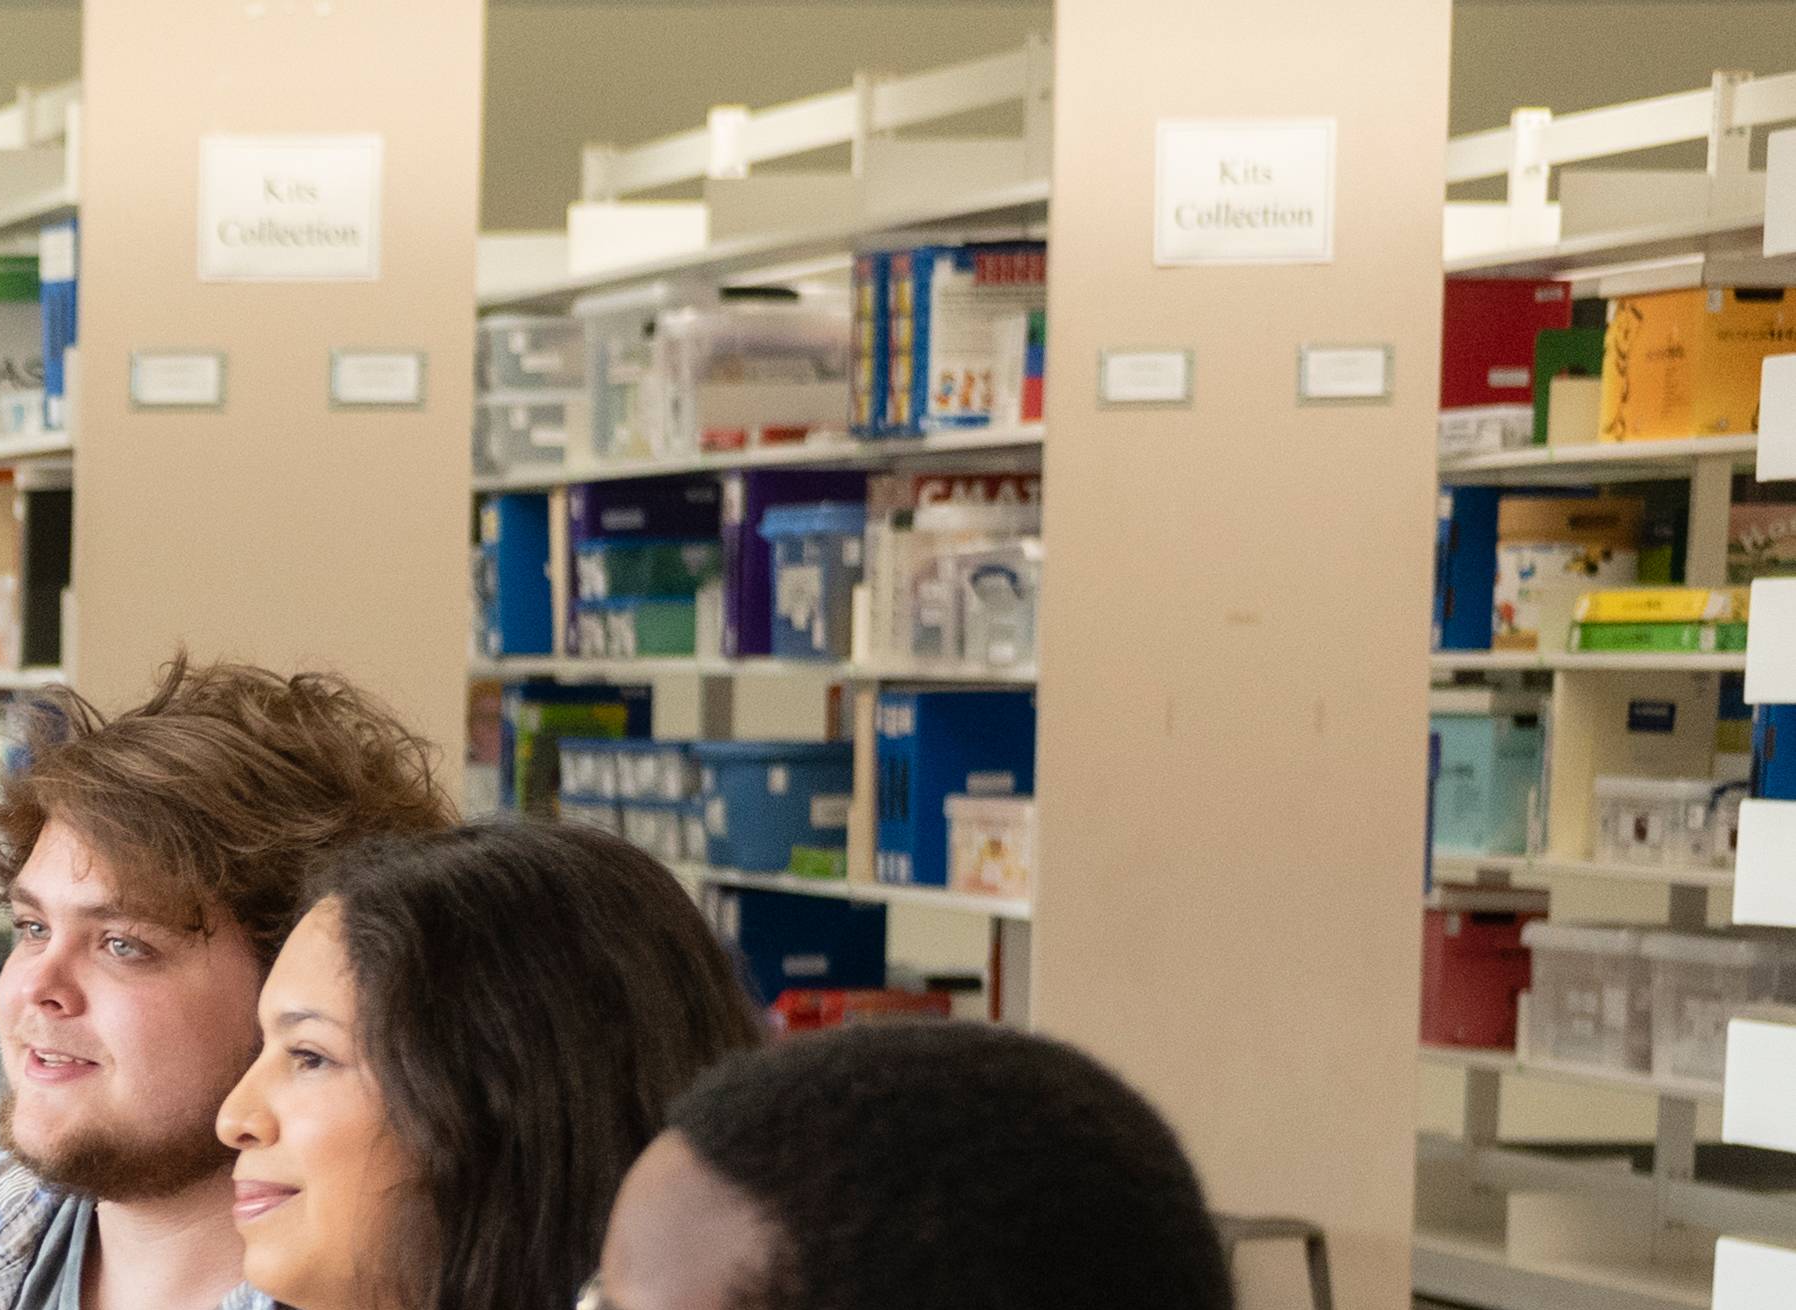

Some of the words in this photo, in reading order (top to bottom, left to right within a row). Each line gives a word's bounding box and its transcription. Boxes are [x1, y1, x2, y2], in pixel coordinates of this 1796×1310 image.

[1218, 157, 1274, 186] Kits
[262, 175, 318, 204] Kits
[1174, 201, 1314, 231] Collection
[217, 218, 361, 248] Collection
